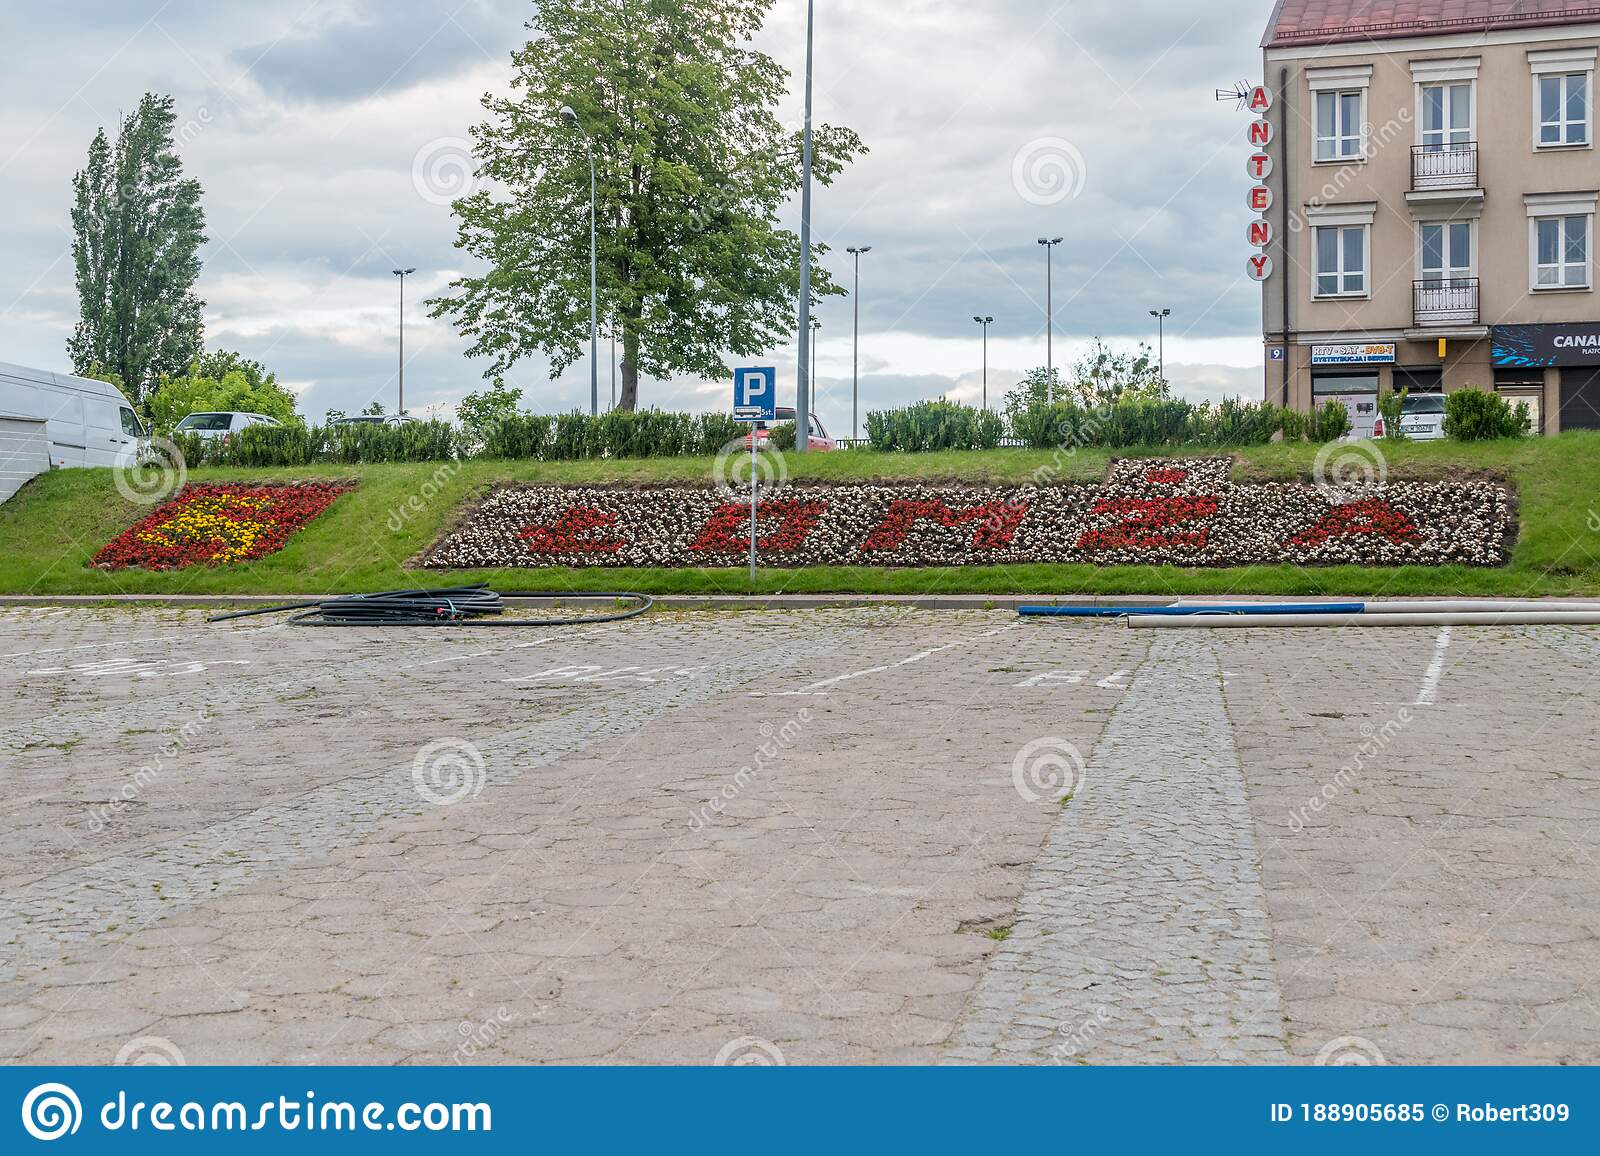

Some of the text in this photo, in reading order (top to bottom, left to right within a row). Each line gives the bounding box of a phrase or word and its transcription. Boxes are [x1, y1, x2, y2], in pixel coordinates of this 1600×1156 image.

[1250, 87, 1269, 277] ANTENY
[1274, 349, 1280, 359] 9
[1313, 346, 1334, 355] RTV
[1339, 346, 1359, 355] SAT
[743, 372, 766, 405] P
